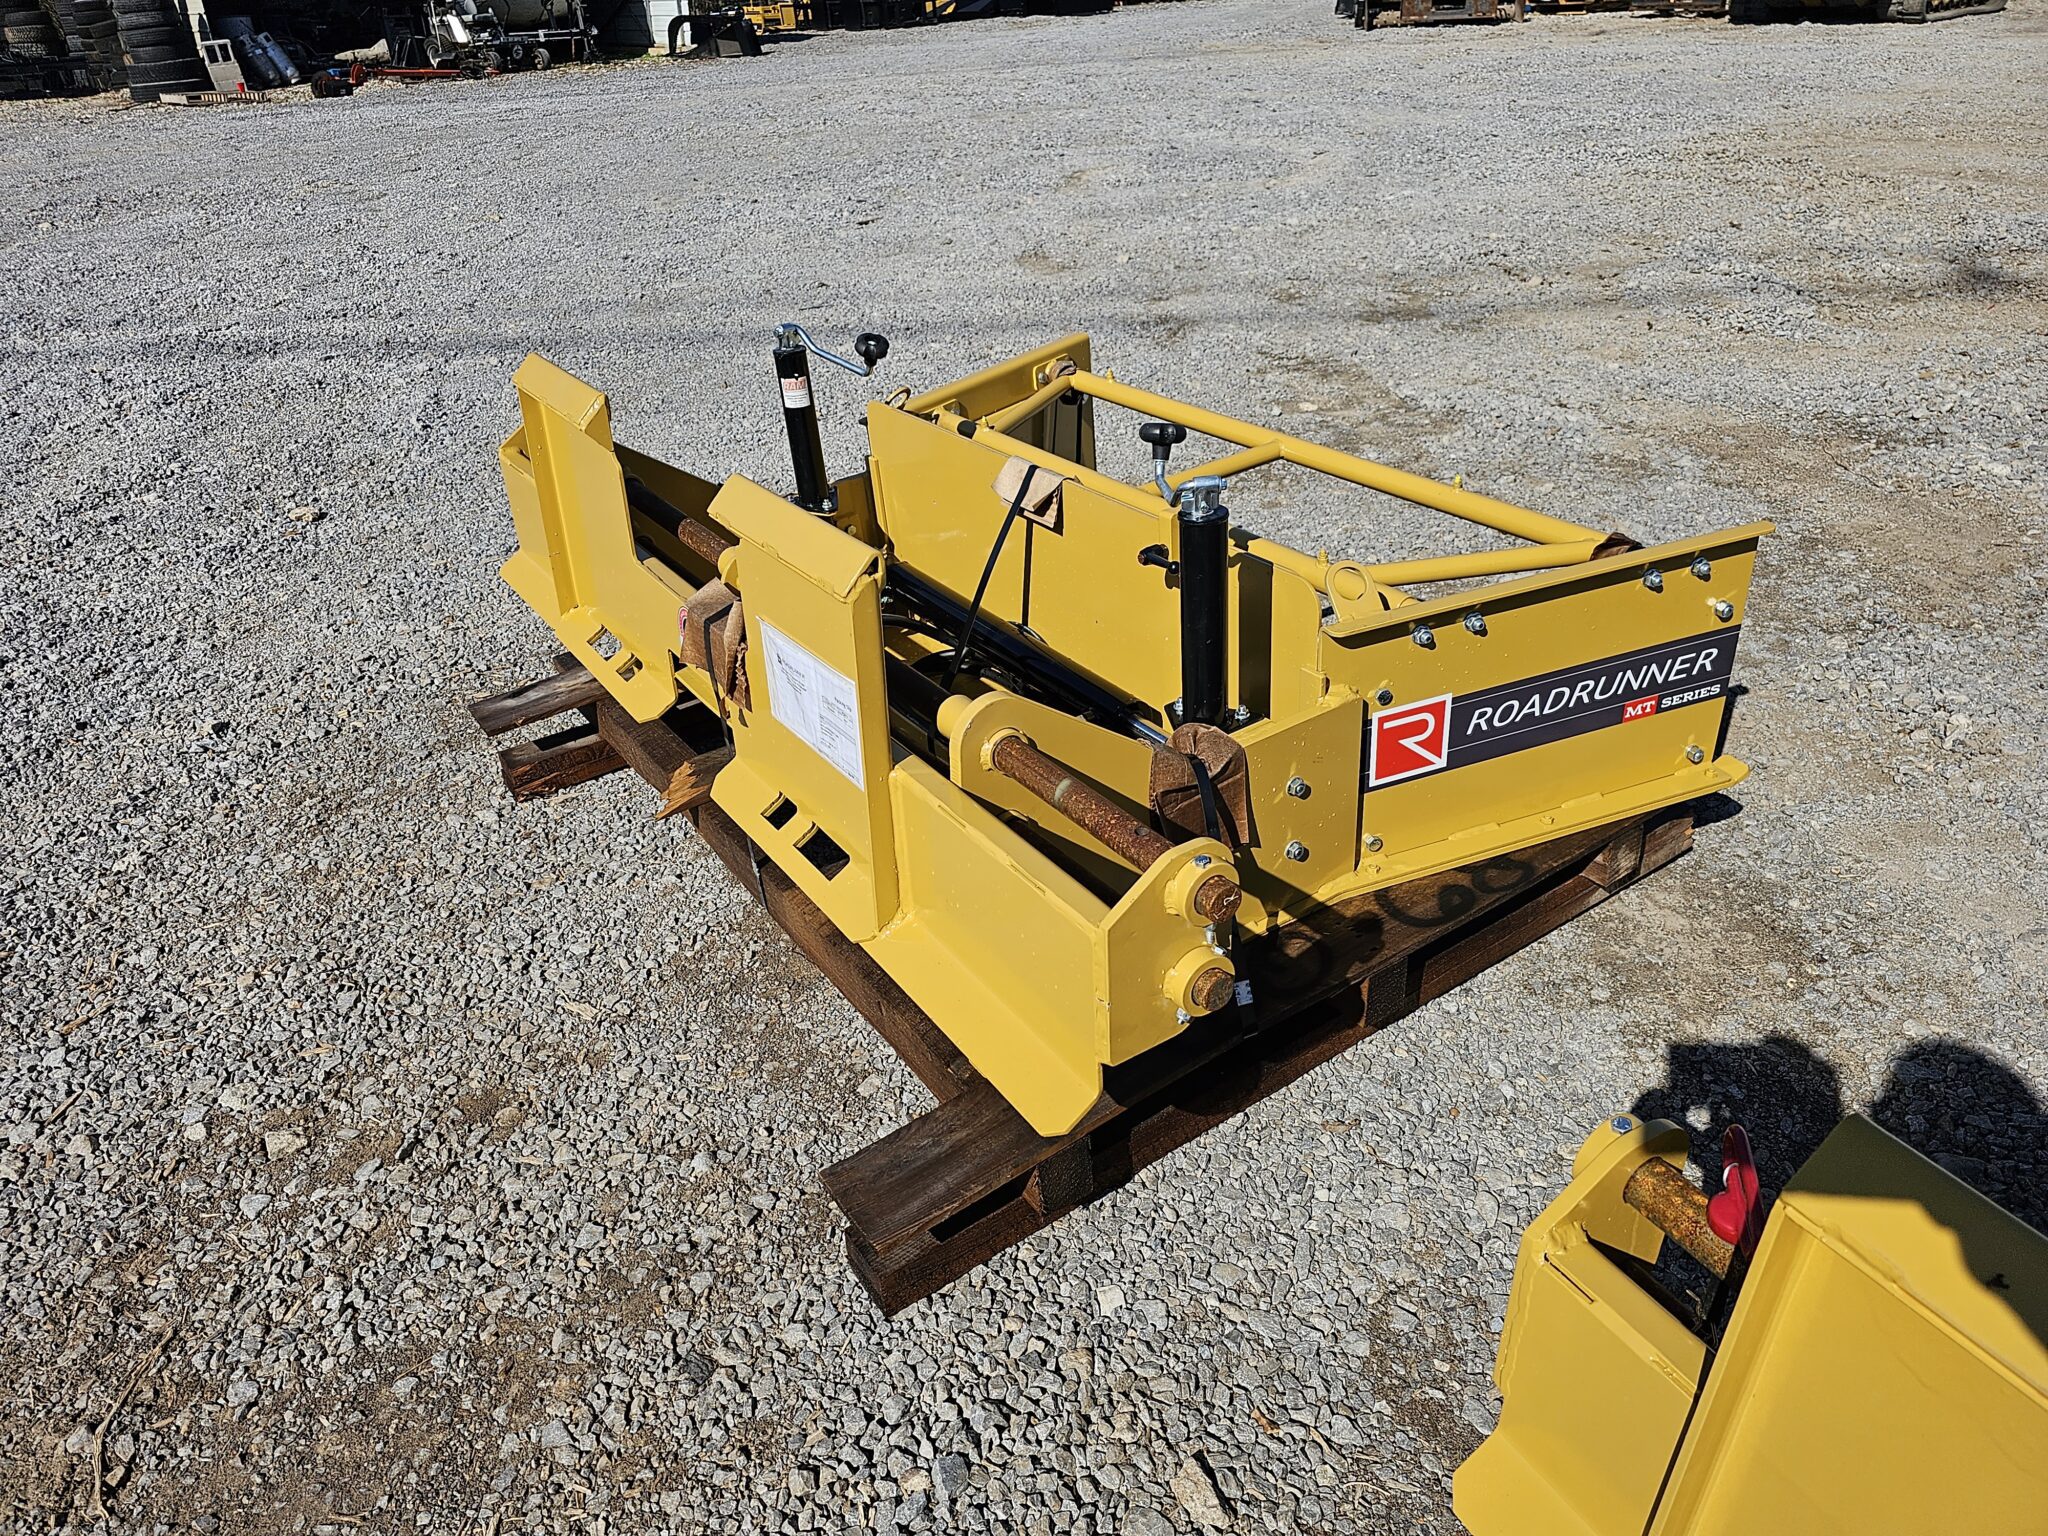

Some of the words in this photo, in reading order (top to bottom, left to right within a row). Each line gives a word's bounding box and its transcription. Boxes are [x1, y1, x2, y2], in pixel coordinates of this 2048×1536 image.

[1466, 647, 1719, 736] ROADRUNNER
[1624, 700, 1656, 718] MT
[1660, 684, 1721, 708] SERIES
